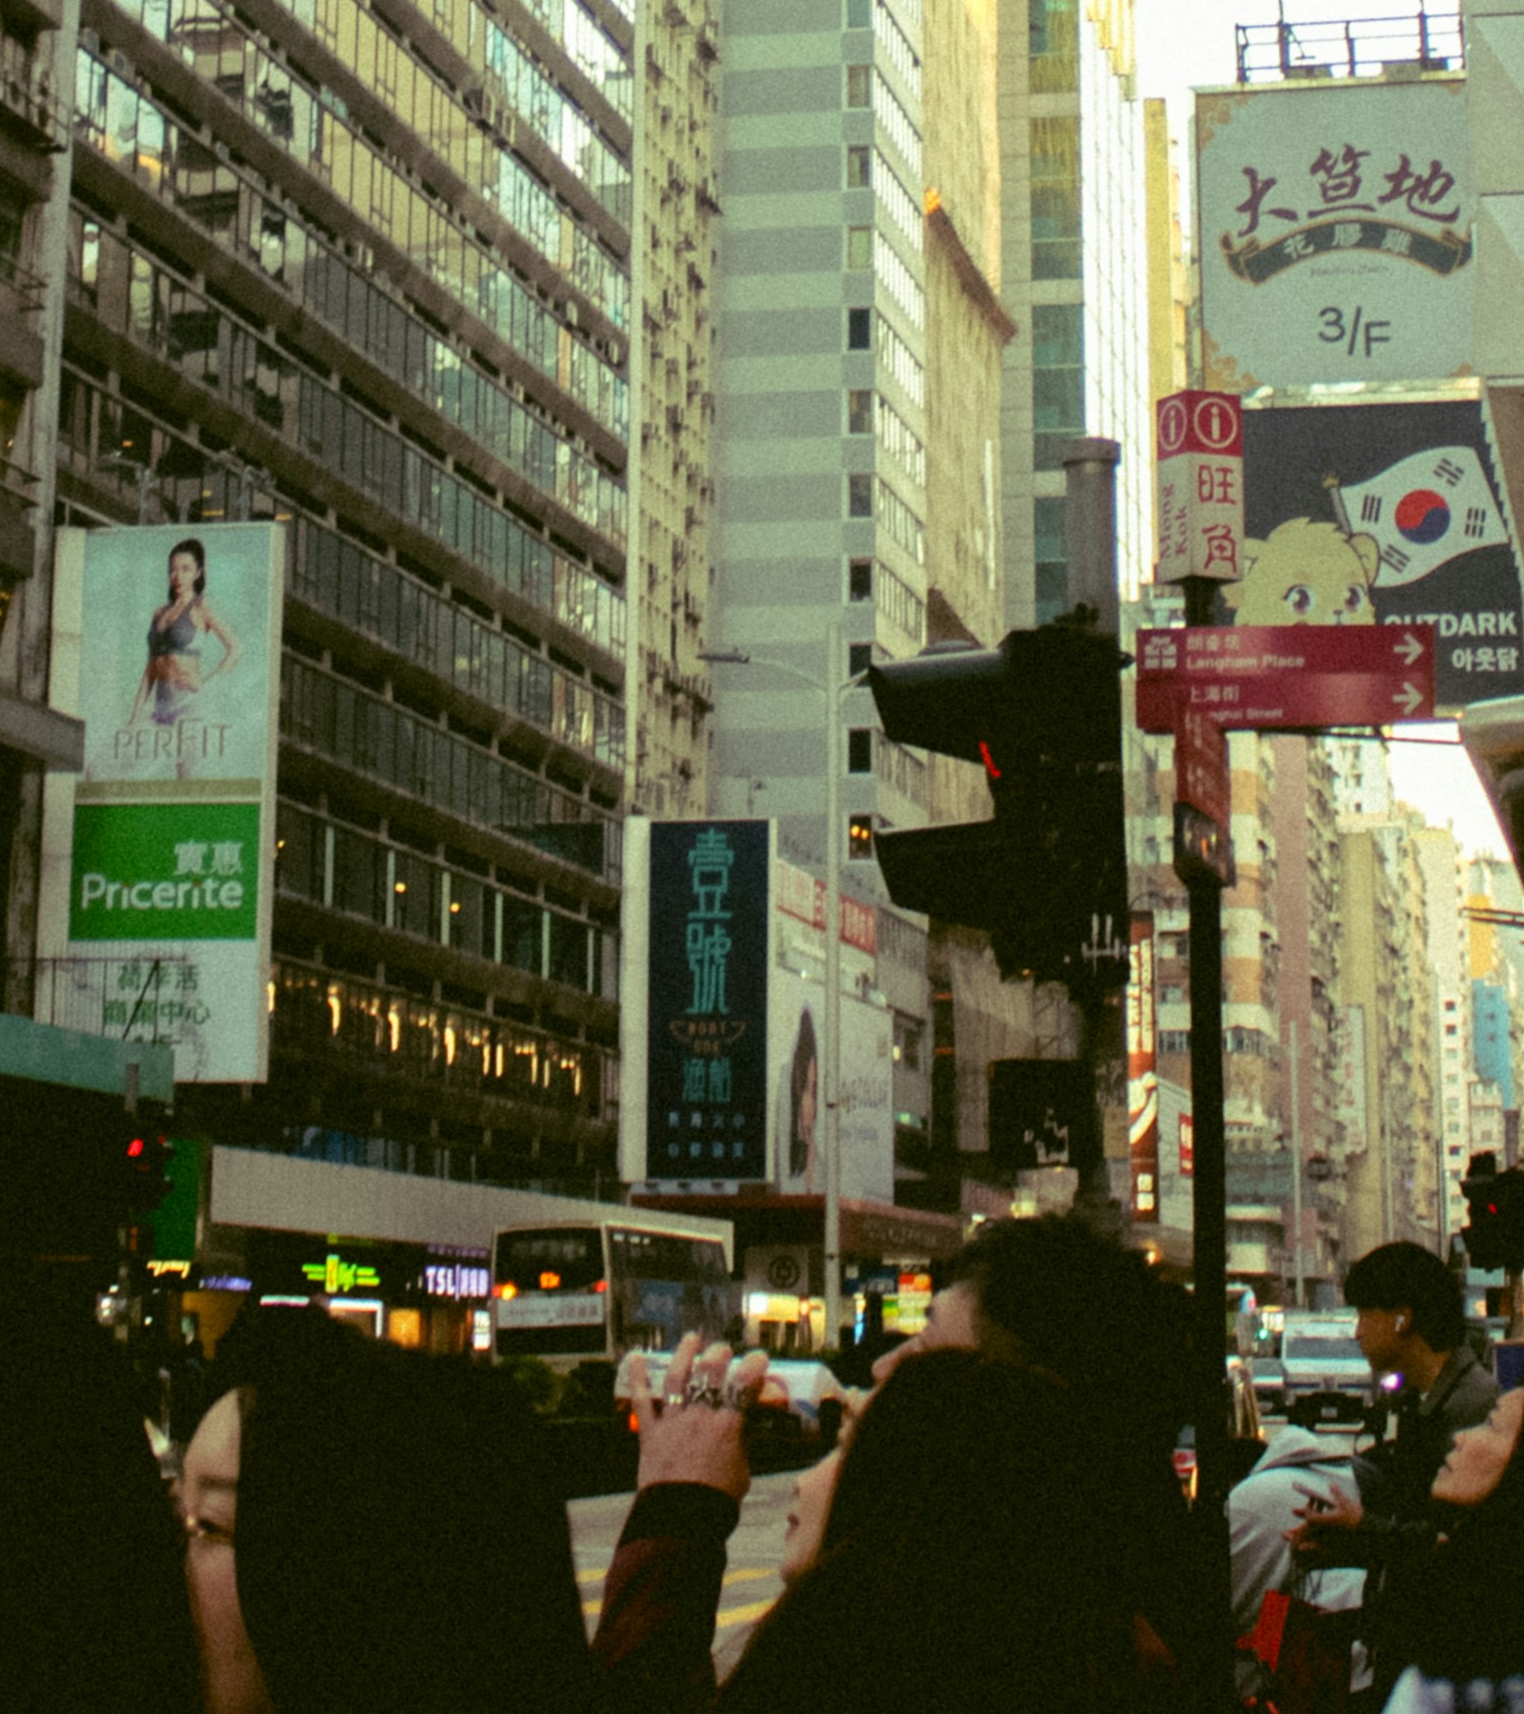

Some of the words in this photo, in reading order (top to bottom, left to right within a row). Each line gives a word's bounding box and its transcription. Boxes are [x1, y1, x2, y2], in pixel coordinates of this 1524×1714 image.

[1236, 143, 1461, 237] 大笪地
[1318, 305, 1391, 357] 3/F
[1159, 483, 1175, 560] Mong
[1175, 505, 1187, 556] Kok
[1197, 464, 1237, 574] 旺角
[1186, 656, 1258, 673] Langham
[1262, 654, 1306, 669] Place
[113, 718, 232, 761] PERFIT
[81, 872, 245, 910] Pricerite
